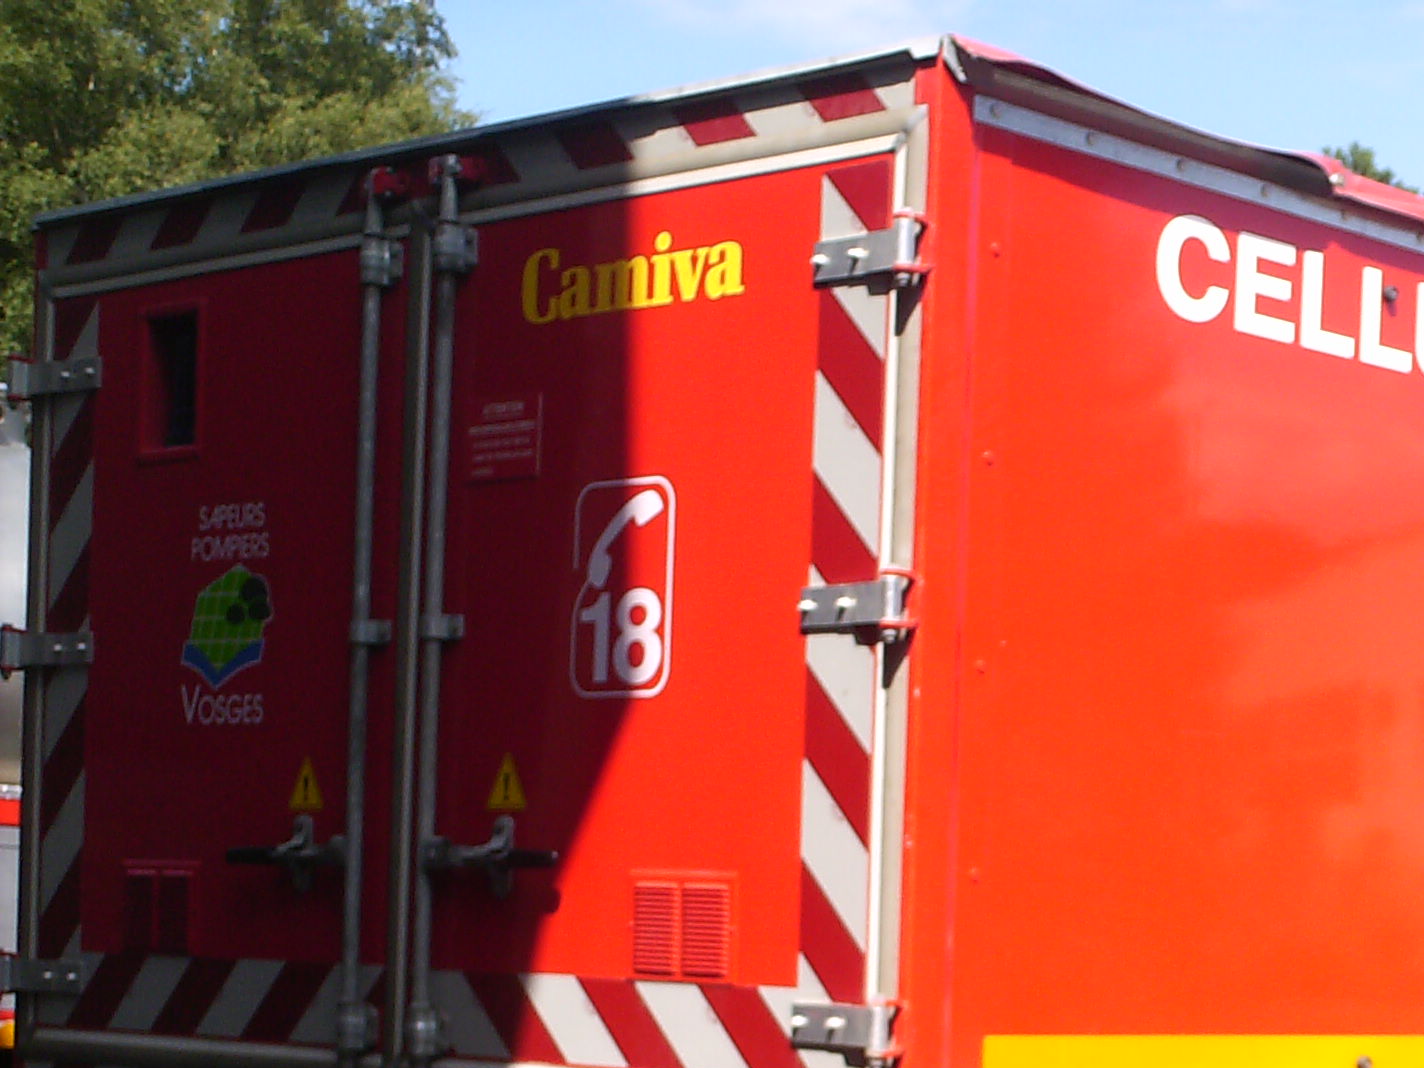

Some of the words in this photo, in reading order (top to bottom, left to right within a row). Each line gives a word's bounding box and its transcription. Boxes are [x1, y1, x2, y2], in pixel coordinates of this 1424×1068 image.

[521, 230, 746, 325] Camiva
[190, 532, 271, 562] POMPIERS
[199, 502, 267, 531] SAPEURS
[579, 586, 663, 685] 18
